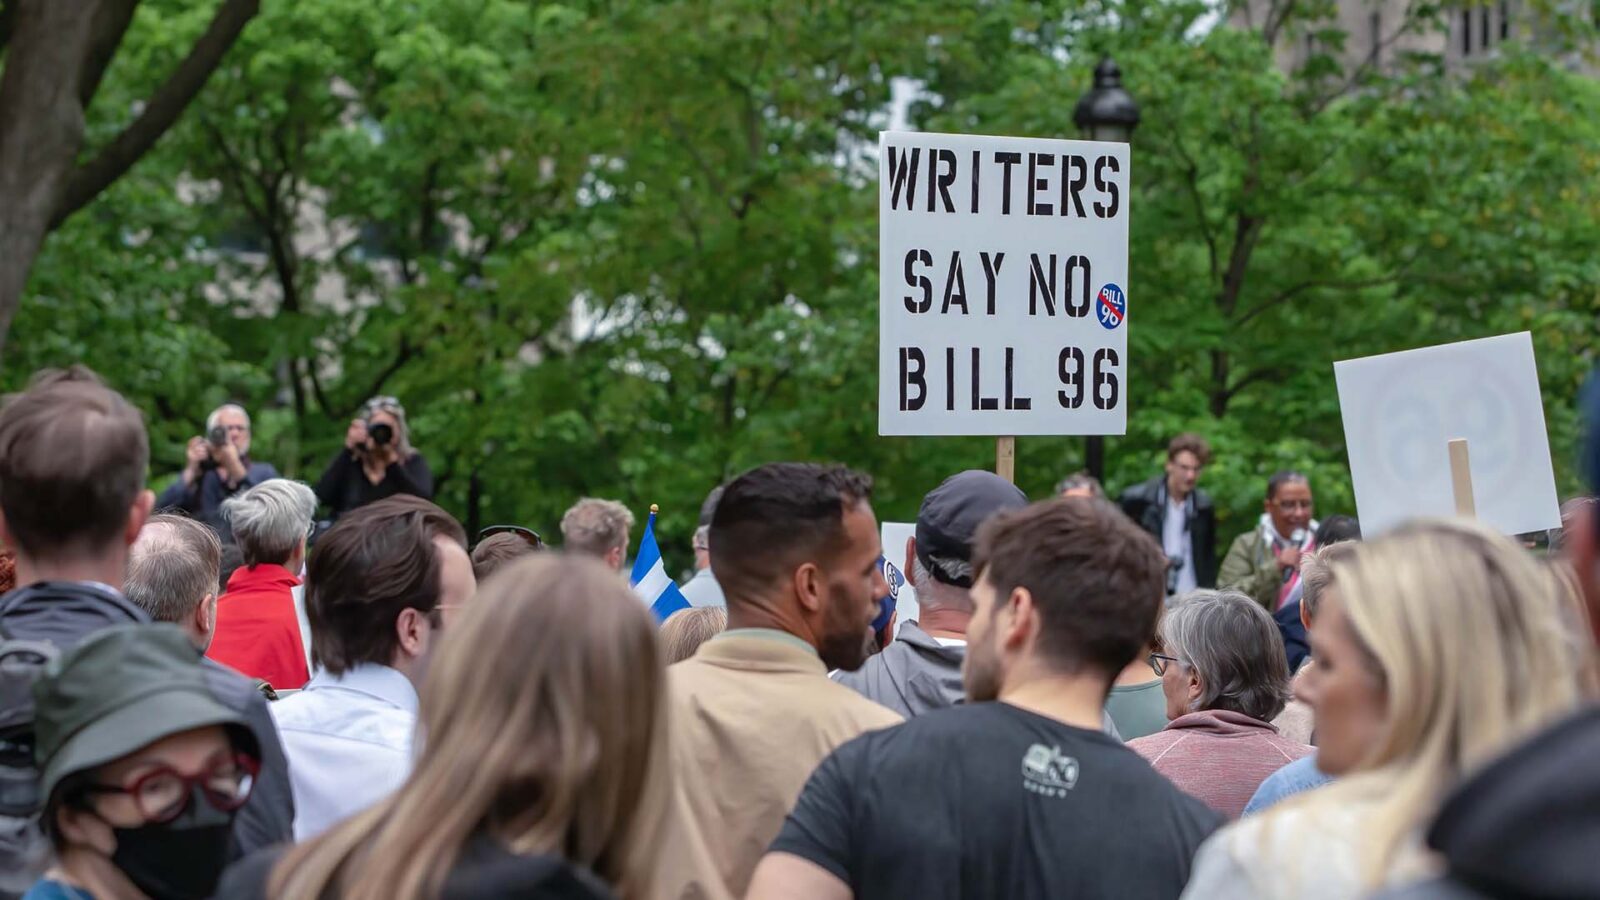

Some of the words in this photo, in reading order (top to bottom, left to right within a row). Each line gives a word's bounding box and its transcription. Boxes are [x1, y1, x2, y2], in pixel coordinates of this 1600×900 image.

[887, 146, 1120, 218] WRITERS
[903, 249, 1005, 315] SAY
[1028, 253, 1091, 317] NO
[1101, 303, 1120, 326] 96
[1102, 287, 1123, 306] BILL
[899, 346, 1032, 411] BILL
[1057, 346, 1119, 410] 96
